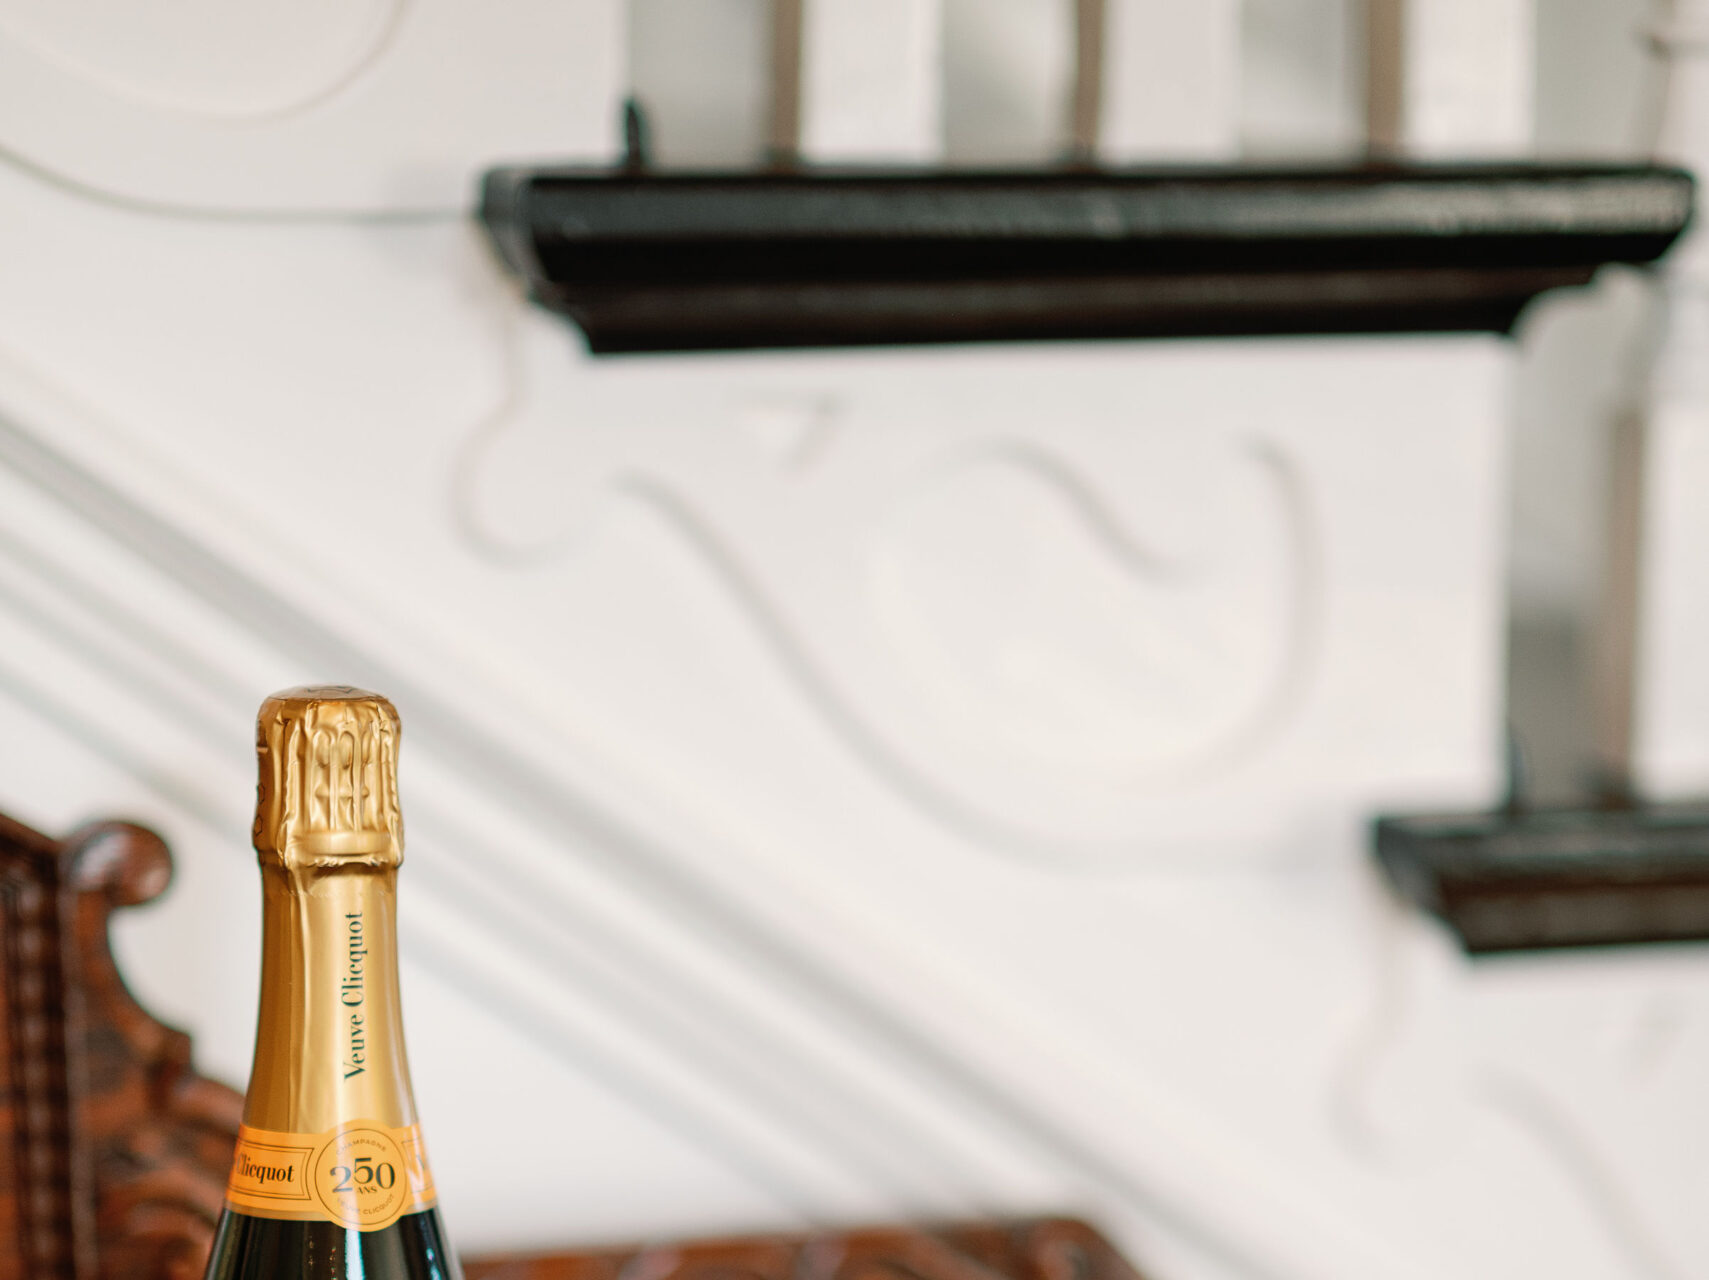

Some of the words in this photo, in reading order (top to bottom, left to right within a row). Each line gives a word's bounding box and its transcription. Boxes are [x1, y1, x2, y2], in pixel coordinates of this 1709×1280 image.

[341, 911, 368, 1008] Clicquot
[343, 1013, 366, 1082] Veuve
[237, 1153, 295, 1184] Clicquot
[329, 1156, 396, 1193] 250
[357, 1186, 378, 1195] ANS
